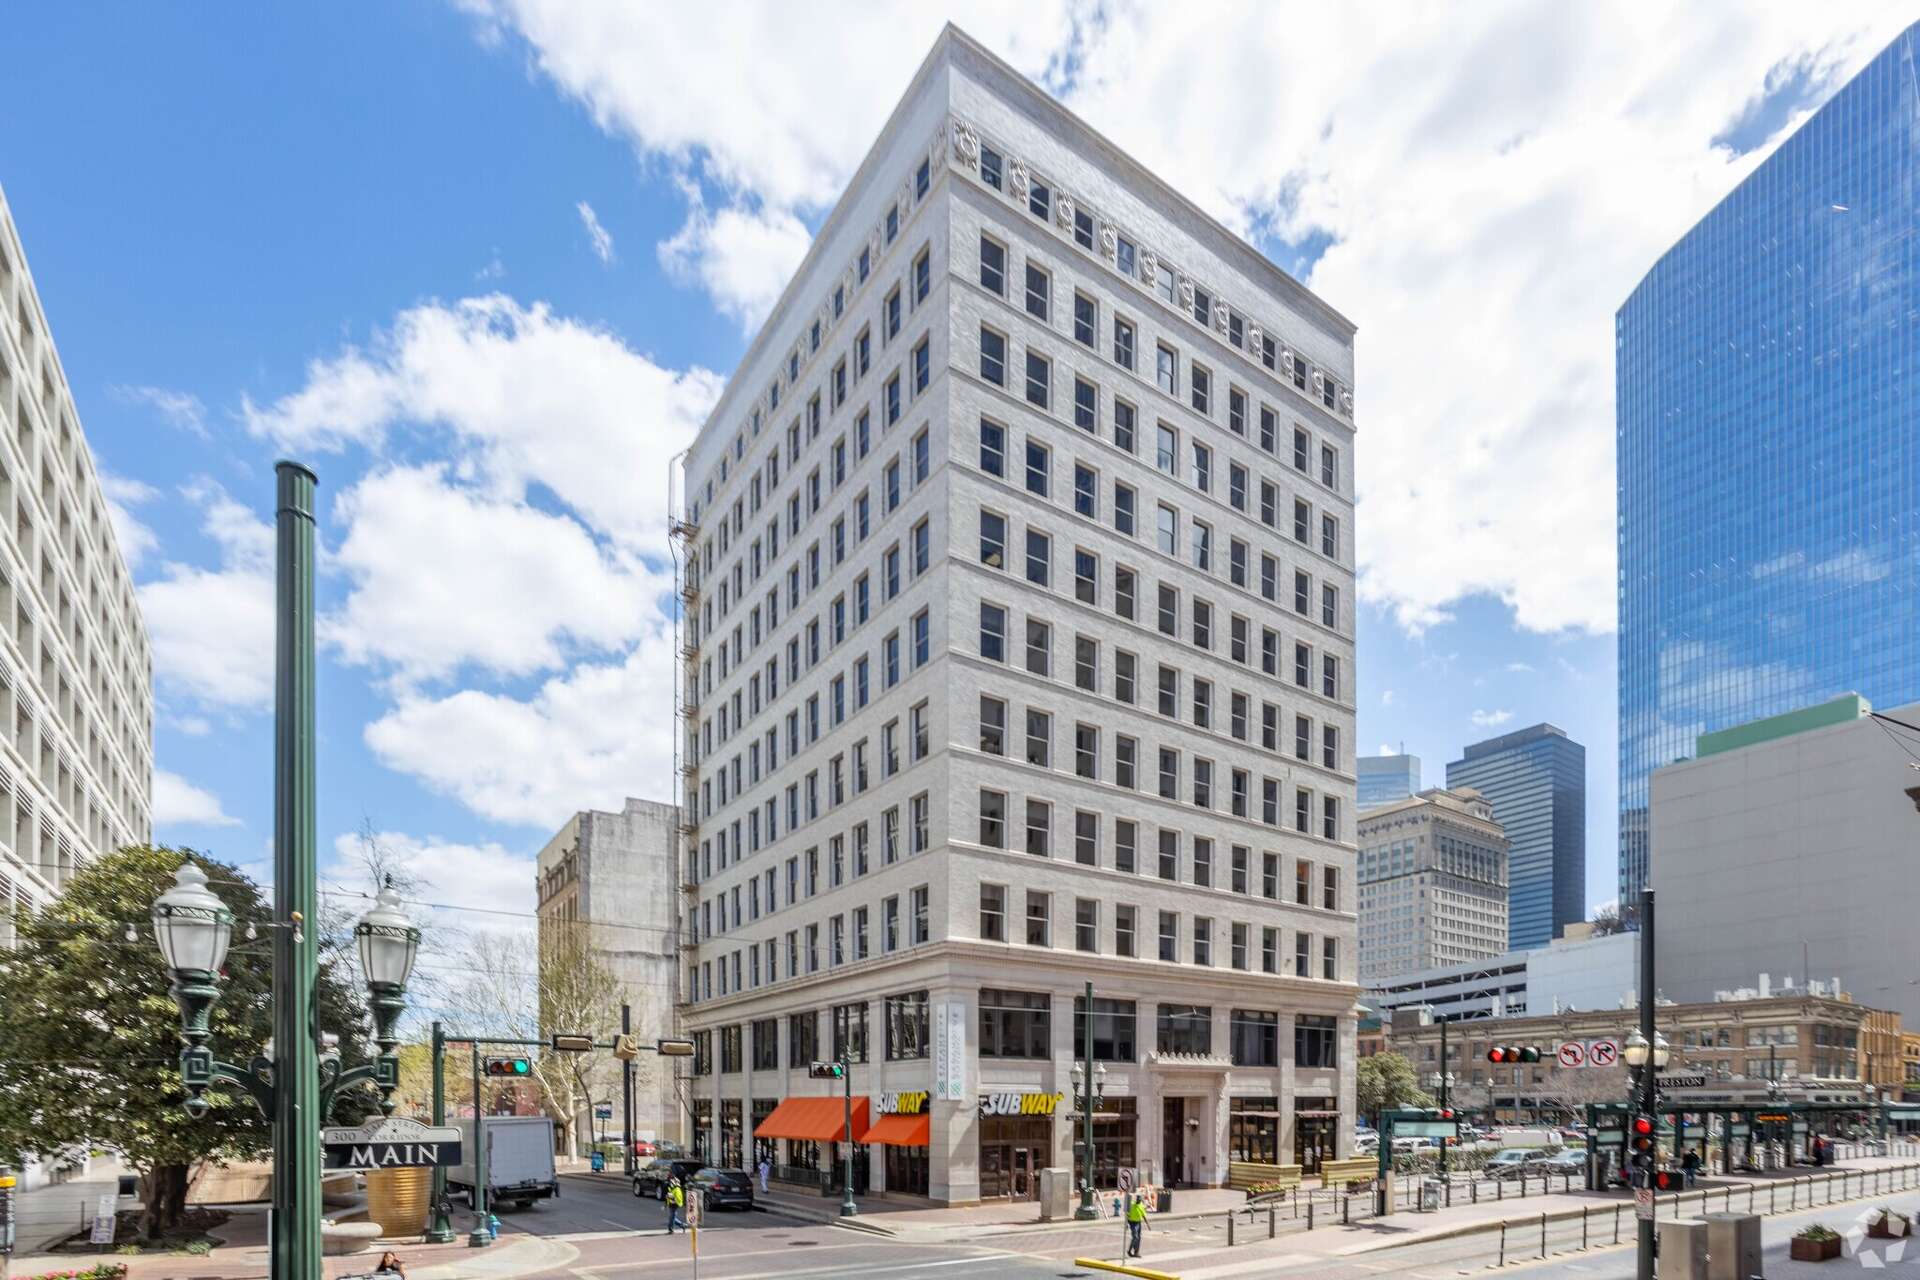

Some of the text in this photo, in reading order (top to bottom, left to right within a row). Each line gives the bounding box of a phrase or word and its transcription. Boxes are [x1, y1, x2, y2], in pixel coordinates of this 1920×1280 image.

[877, 1090, 928, 1113] SUBWAY
[980, 1091, 1064, 1115] SUBWAY
[392, 1120, 427, 1134] STREET
[332, 1132, 357, 1141] 300
[368, 1133, 421, 1141] CORRIDOR
[350, 1144, 439, 1167] MAIN
